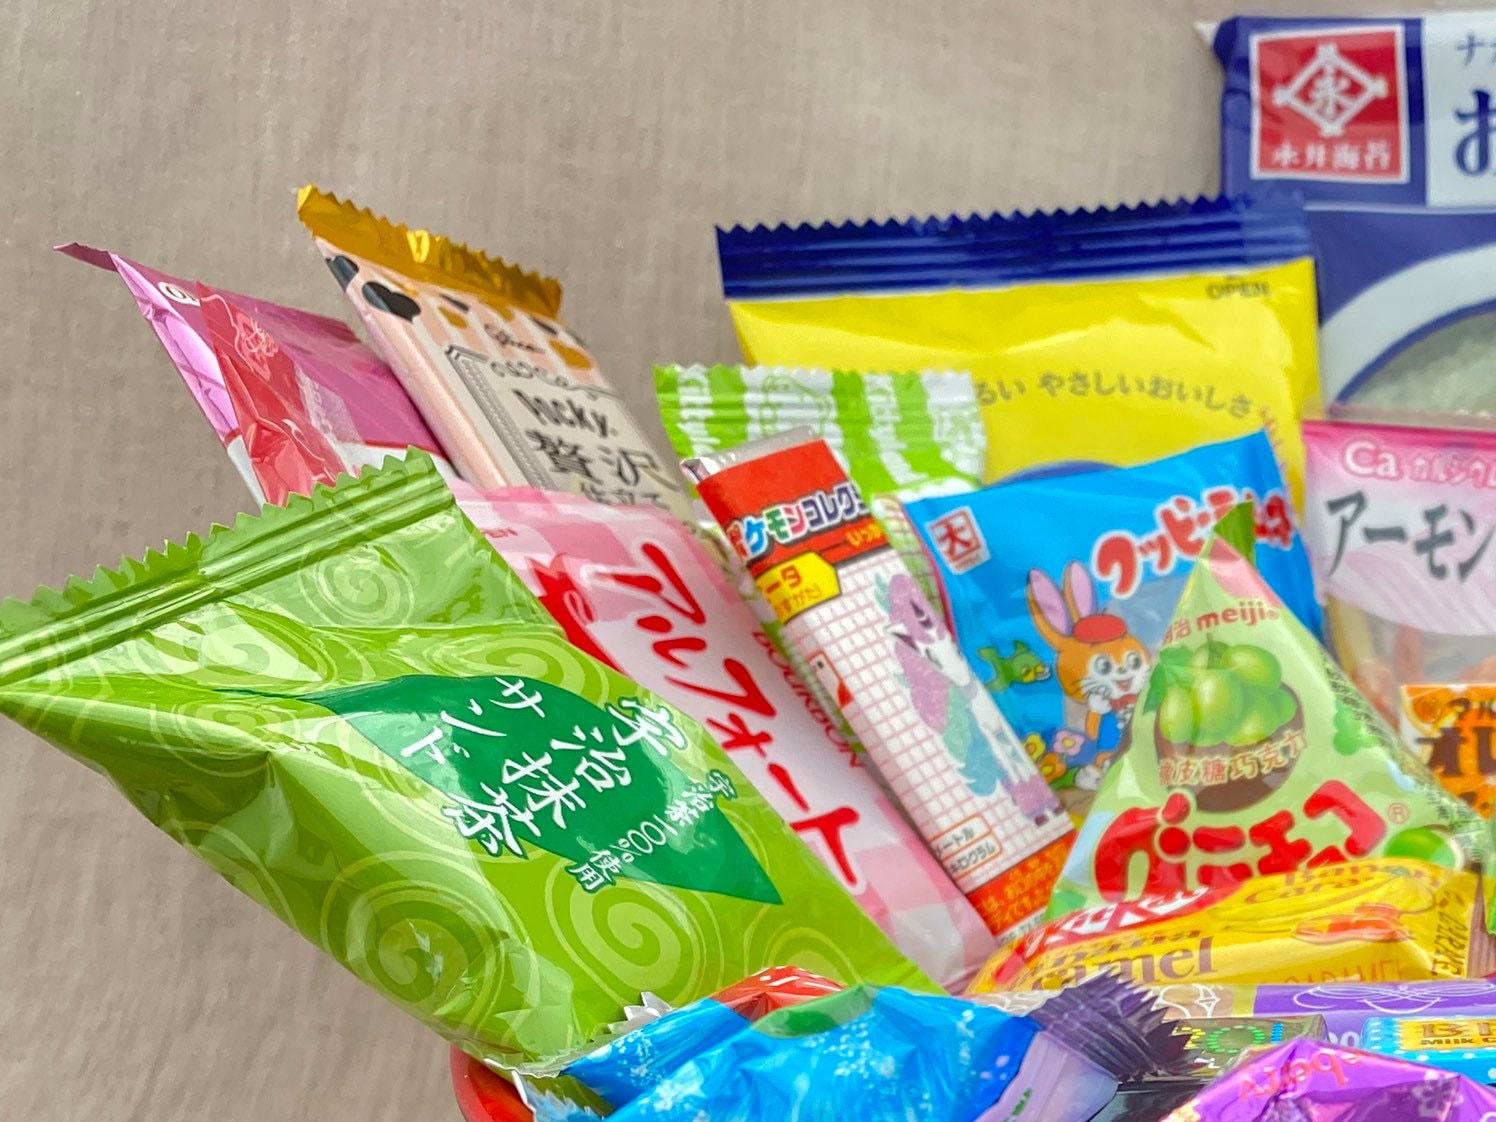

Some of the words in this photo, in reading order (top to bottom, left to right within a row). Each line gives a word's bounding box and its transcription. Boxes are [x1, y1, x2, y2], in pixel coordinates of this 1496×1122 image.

[1206, 278, 1271, 300] OPEN
[975, 377, 1026, 407] るい
[1037, 370, 1252, 418] やさしいおいしさ
[1344, 441, 1399, 478] Ca
[1196, 601, 1266, 632] meiji
[399, 676, 548, 769] サンド
[590, 541, 861, 886] アルフォート
[441, 694, 690, 860] 宇治抹茶
